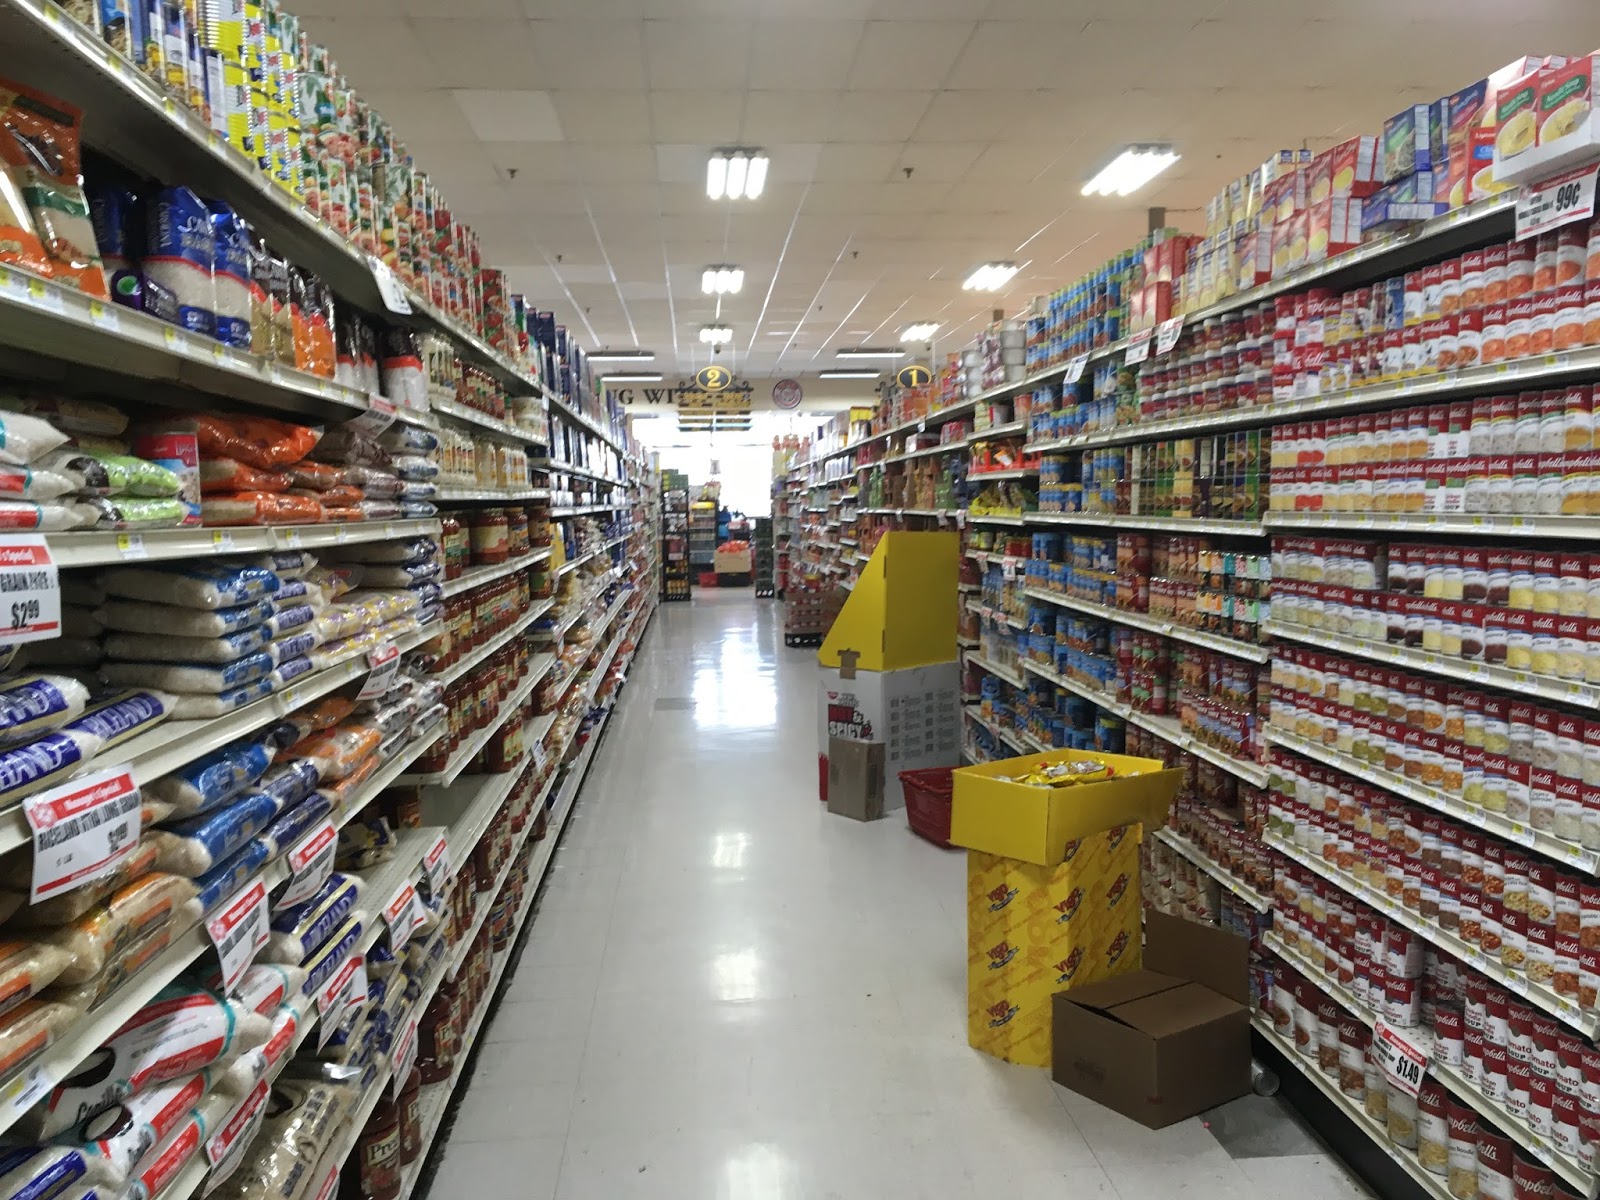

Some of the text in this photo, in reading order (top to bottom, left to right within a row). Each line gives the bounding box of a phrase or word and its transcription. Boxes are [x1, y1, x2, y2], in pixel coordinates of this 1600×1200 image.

[1556, 181, 1581, 212] 99¢
[706, 369, 721, 388] 2
[908, 369, 918, 388] 1
[1397, 1055, 1420, 1085] $1.49
